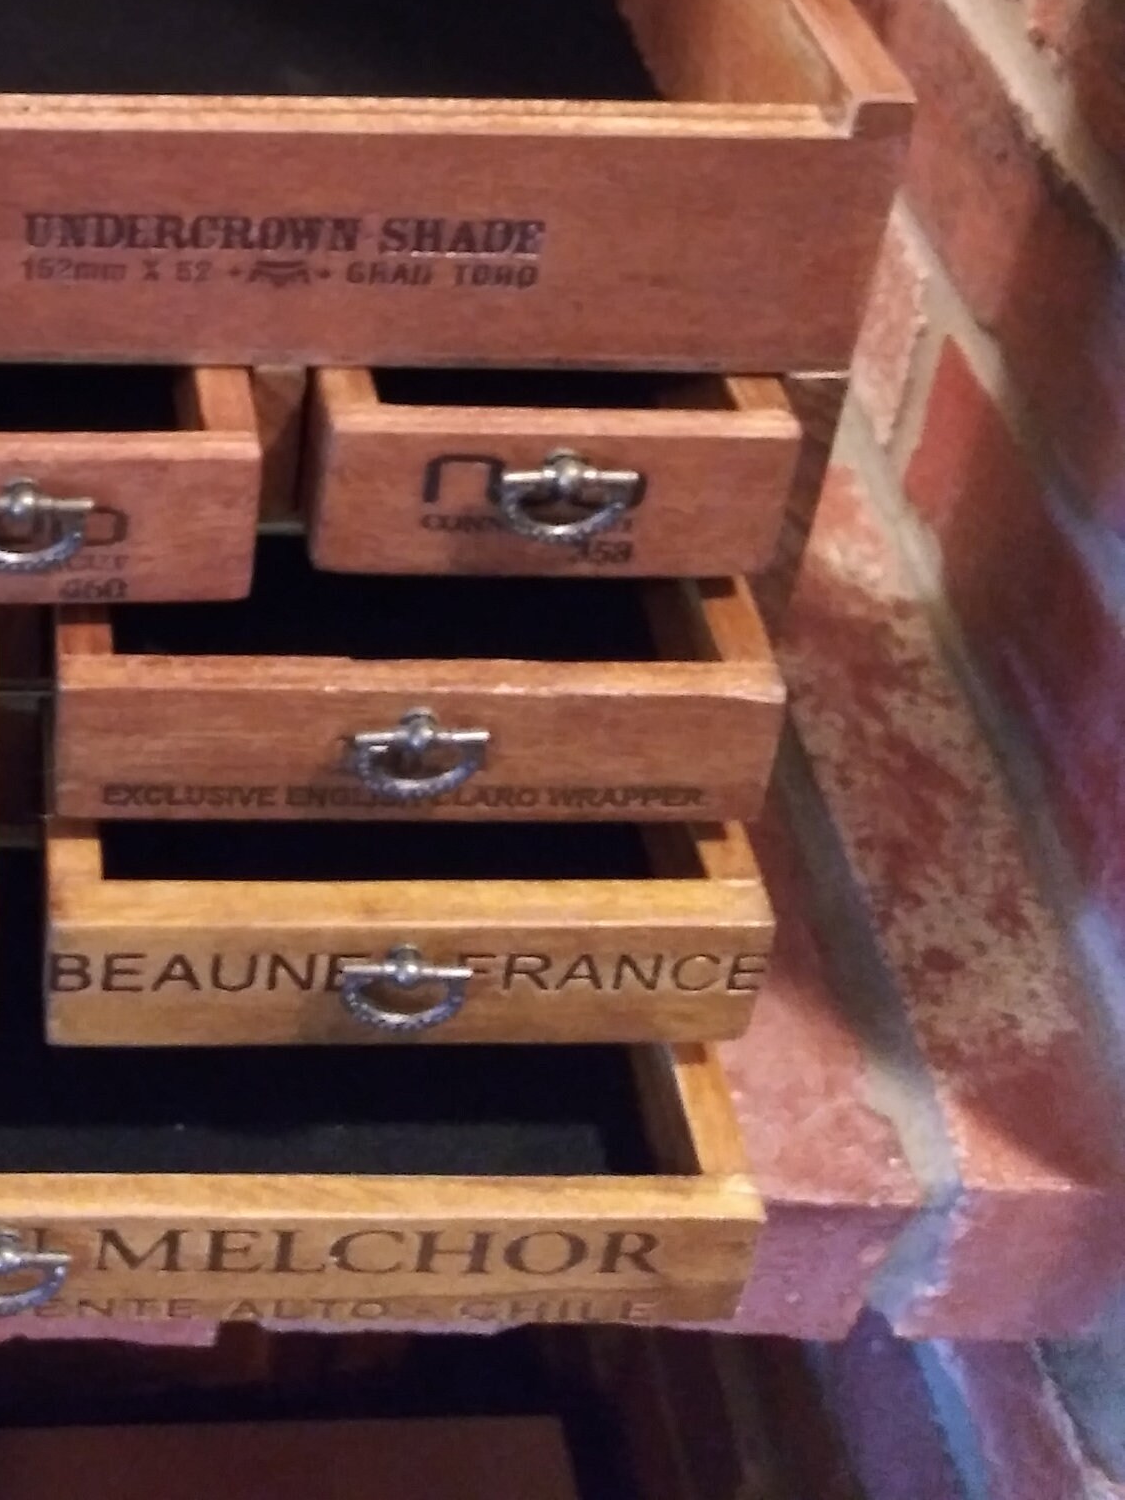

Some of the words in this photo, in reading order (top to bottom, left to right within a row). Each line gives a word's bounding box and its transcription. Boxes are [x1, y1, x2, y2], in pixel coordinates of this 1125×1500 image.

[24, 212, 362, 252] UNDERCROWN
[379, 216, 547, 256] SHADE
[103, 783, 277, 807] EXCLUSIVE
[549, 784, 705, 808] WRAPPER
[50, 951, 371, 994] BEAUNE
[93, 1227, 661, 1276] MELCHOR
